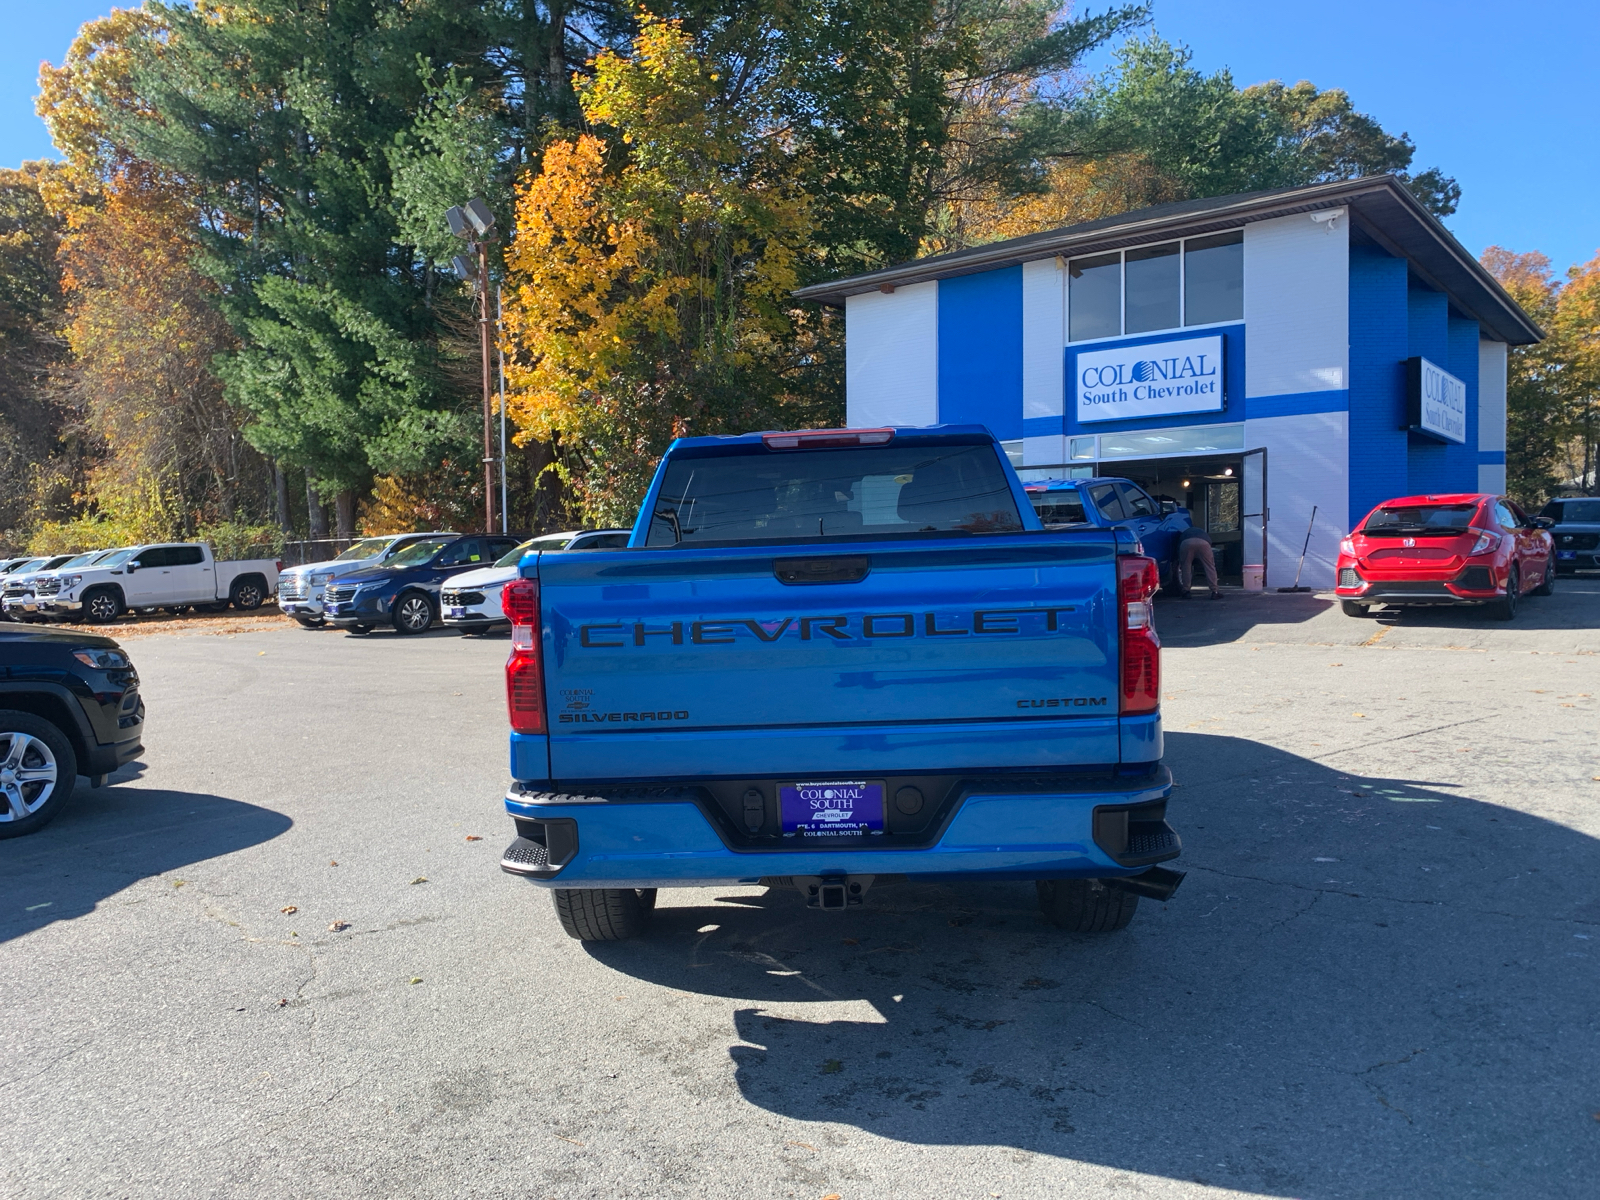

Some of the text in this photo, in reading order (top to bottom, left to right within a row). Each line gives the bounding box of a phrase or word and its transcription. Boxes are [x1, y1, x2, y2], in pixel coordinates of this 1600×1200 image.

[1082, 354, 1216, 389] COLONIAL
[1083, 379, 1216, 406] South Chevrolet
[580, 606, 1076, 648] CHEVROLET
[1016, 697, 1107, 709] CUSTOM
[558, 710, 689, 724] SILVERADO
[800, 789, 863, 800] COLONIAL
[810, 799, 854, 810] SOUTH
